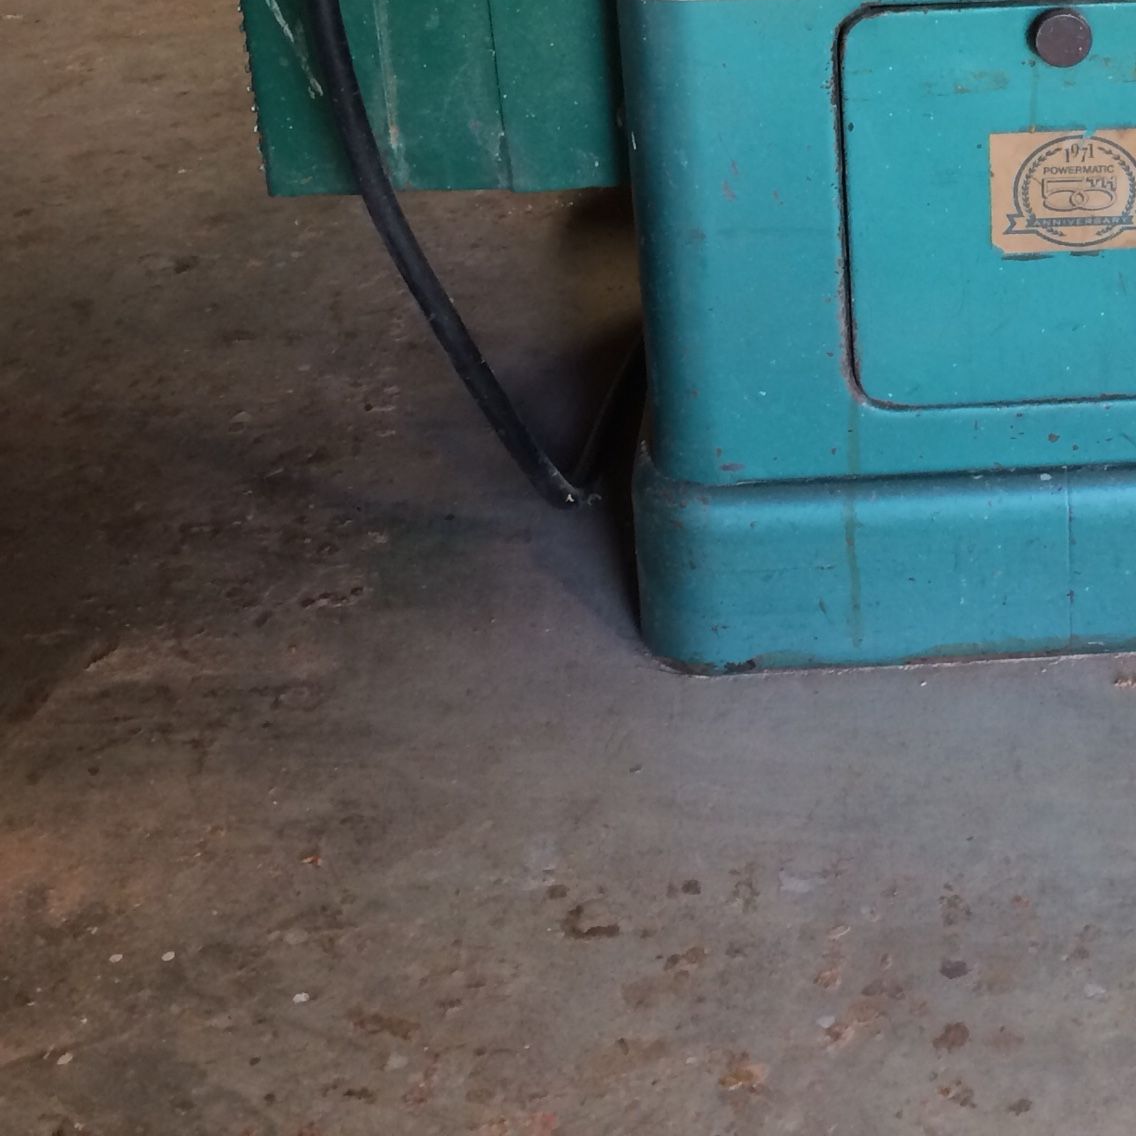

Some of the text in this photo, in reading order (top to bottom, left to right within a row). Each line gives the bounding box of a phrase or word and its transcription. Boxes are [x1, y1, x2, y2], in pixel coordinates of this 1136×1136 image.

[1064, 143, 1095, 163] 1971
[1043, 164, 1115, 175] POWERMATIC
[1033, 216, 1129, 227] ANNIVERSARY
